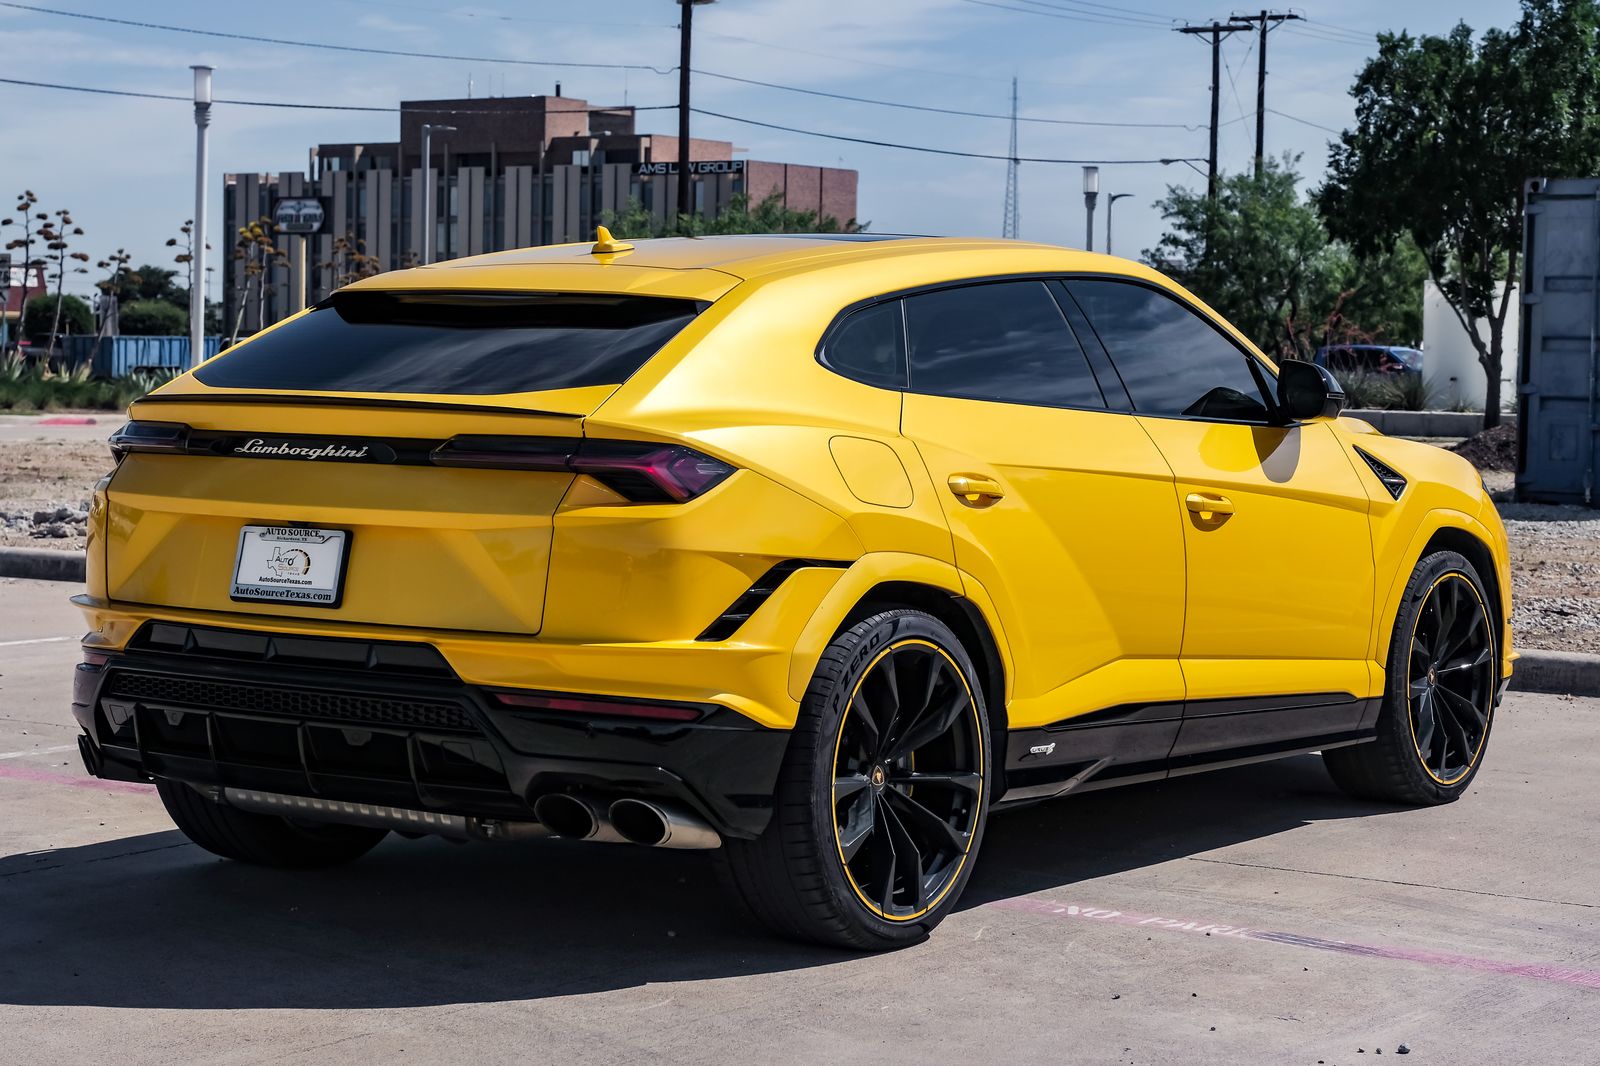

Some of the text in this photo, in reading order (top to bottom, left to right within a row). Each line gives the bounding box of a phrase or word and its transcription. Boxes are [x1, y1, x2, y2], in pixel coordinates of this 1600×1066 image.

[639, 162, 743, 174] AMS LW GROUP
[234, 439, 368, 459] Lamborghini
[265, 528, 320, 538] AUTO SOURCE
[259, 576, 312, 585] AutoSourceTexas.com
[233, 586, 331, 601] AutoSourceTexas.com
[841, 633, 880, 693] ZERO
